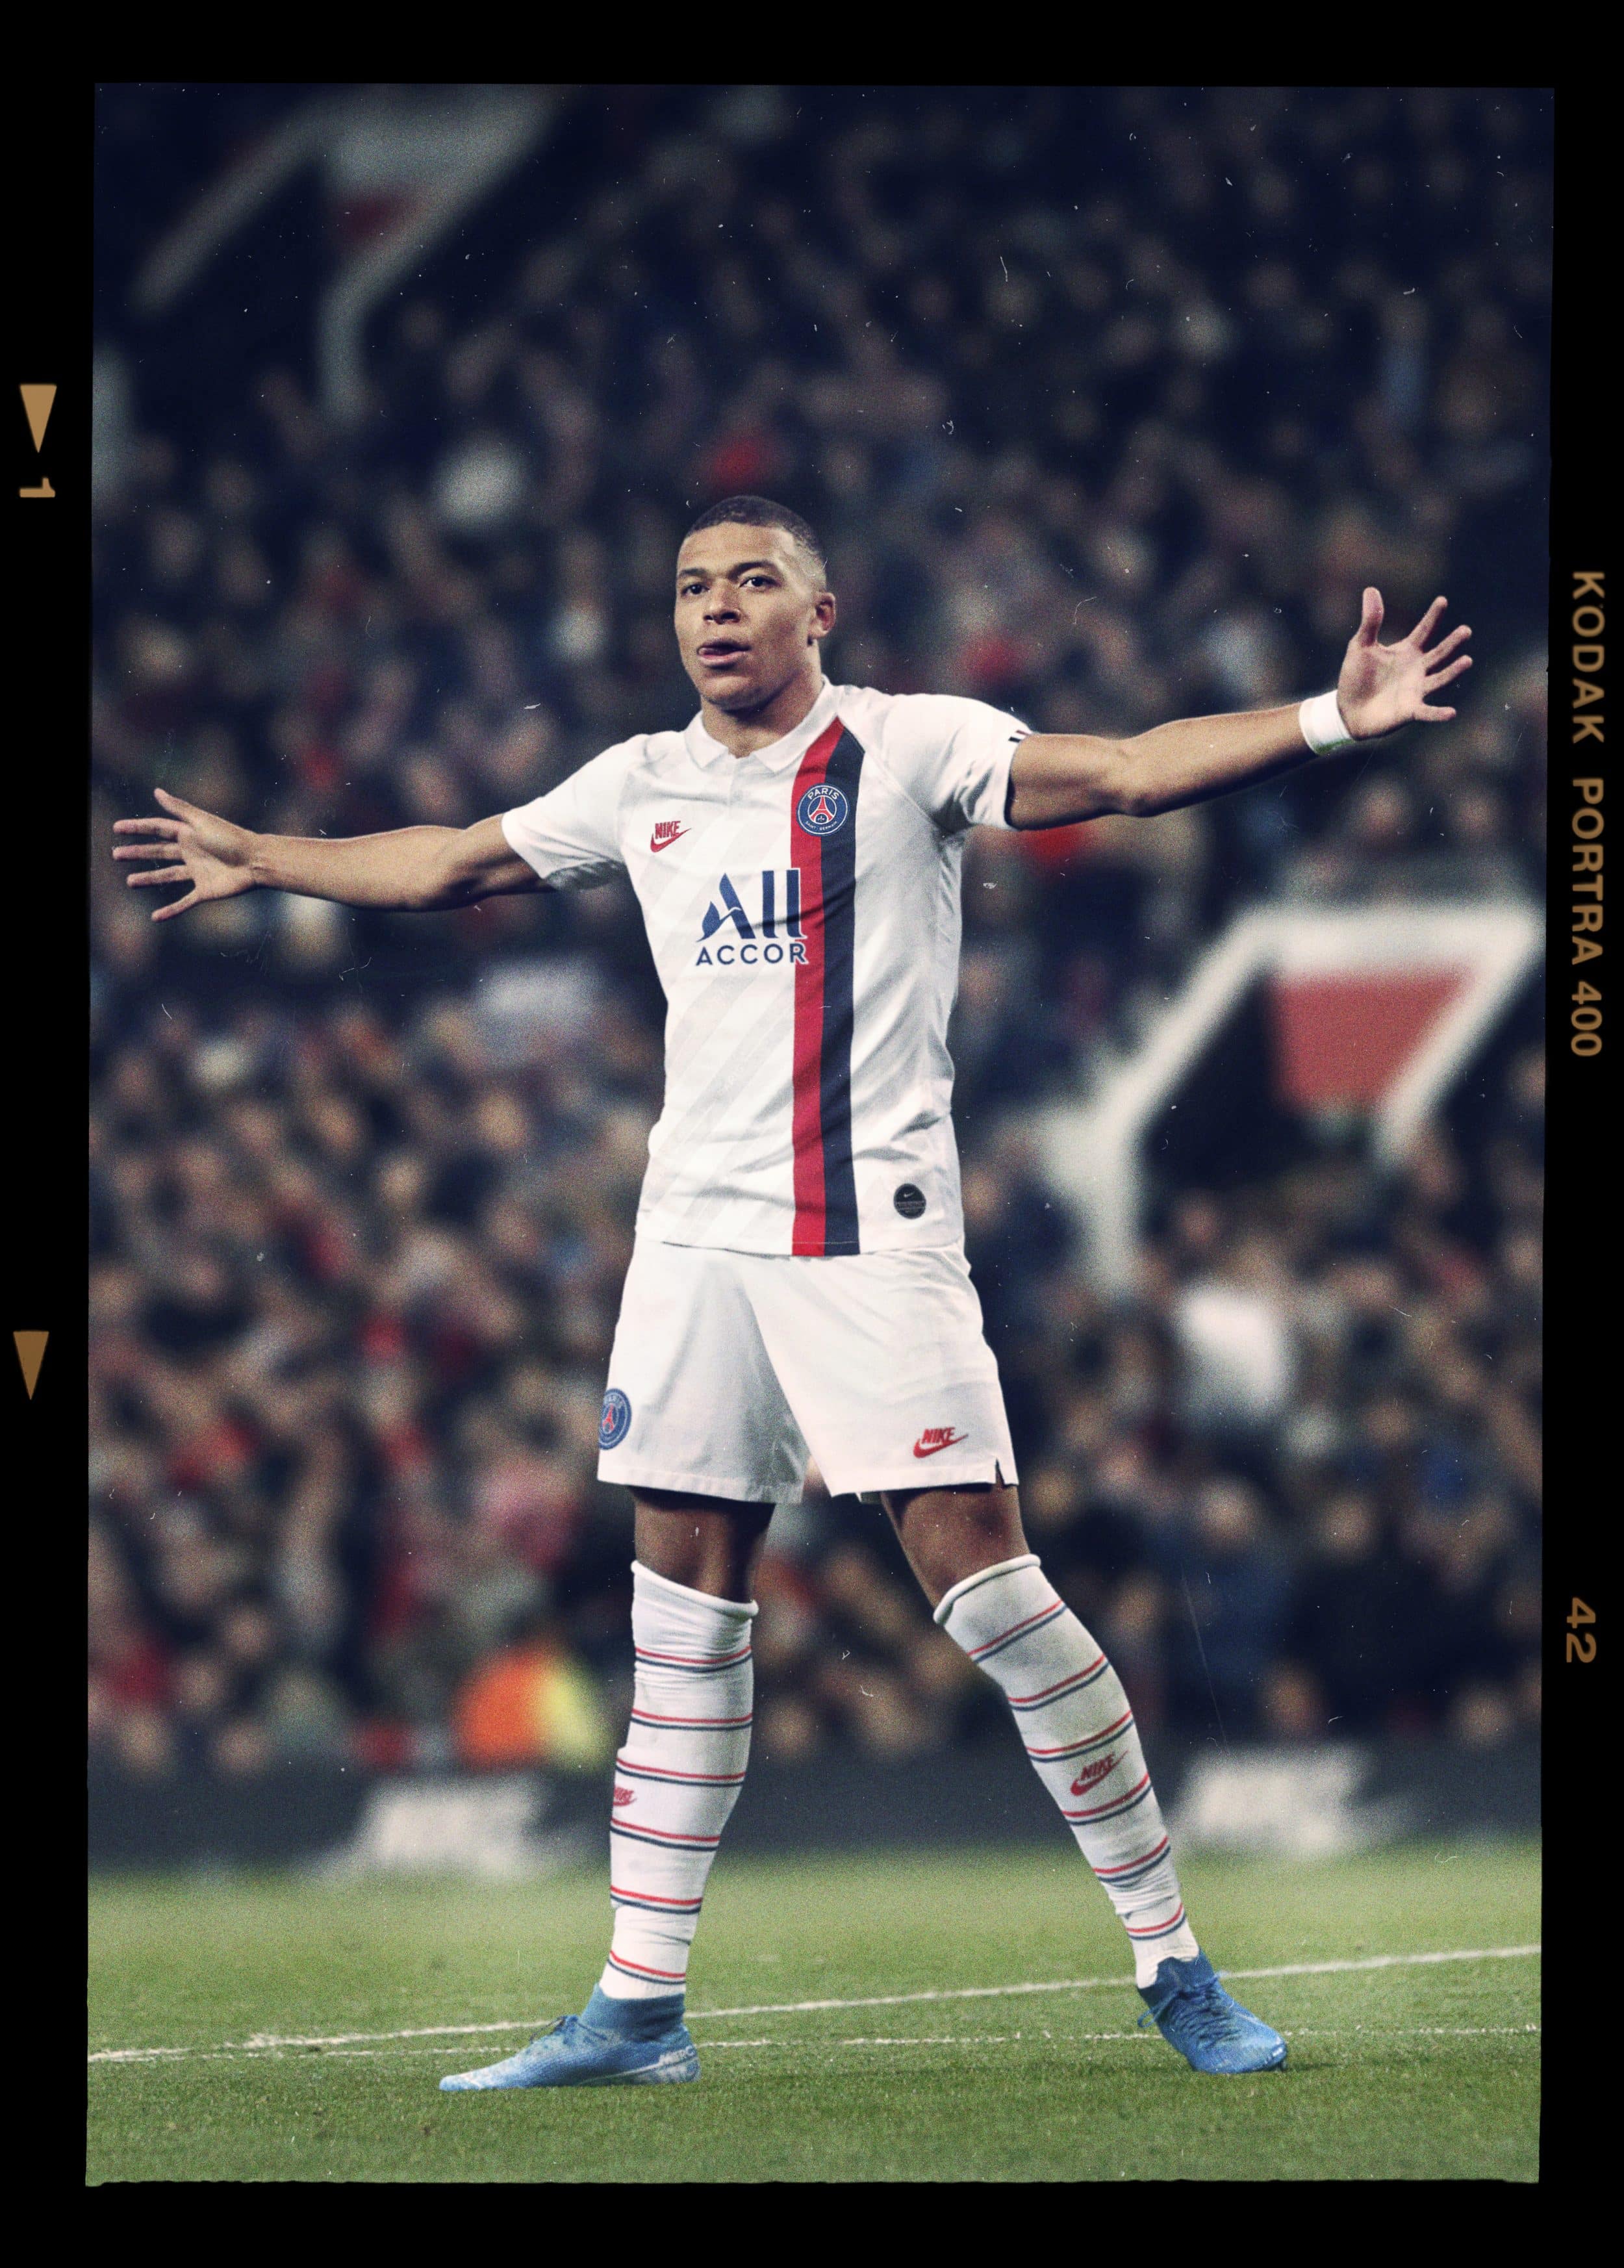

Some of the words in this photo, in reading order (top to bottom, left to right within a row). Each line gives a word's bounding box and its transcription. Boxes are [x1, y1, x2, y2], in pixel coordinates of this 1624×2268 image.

[807, 787, 840, 800] PARIS
[655, 820, 681, 839] NIKE
[695, 942, 809, 966] ACCOR
[921, 1427, 956, 1444] NIKE
[1080, 1752, 1115, 1779] NIKE
